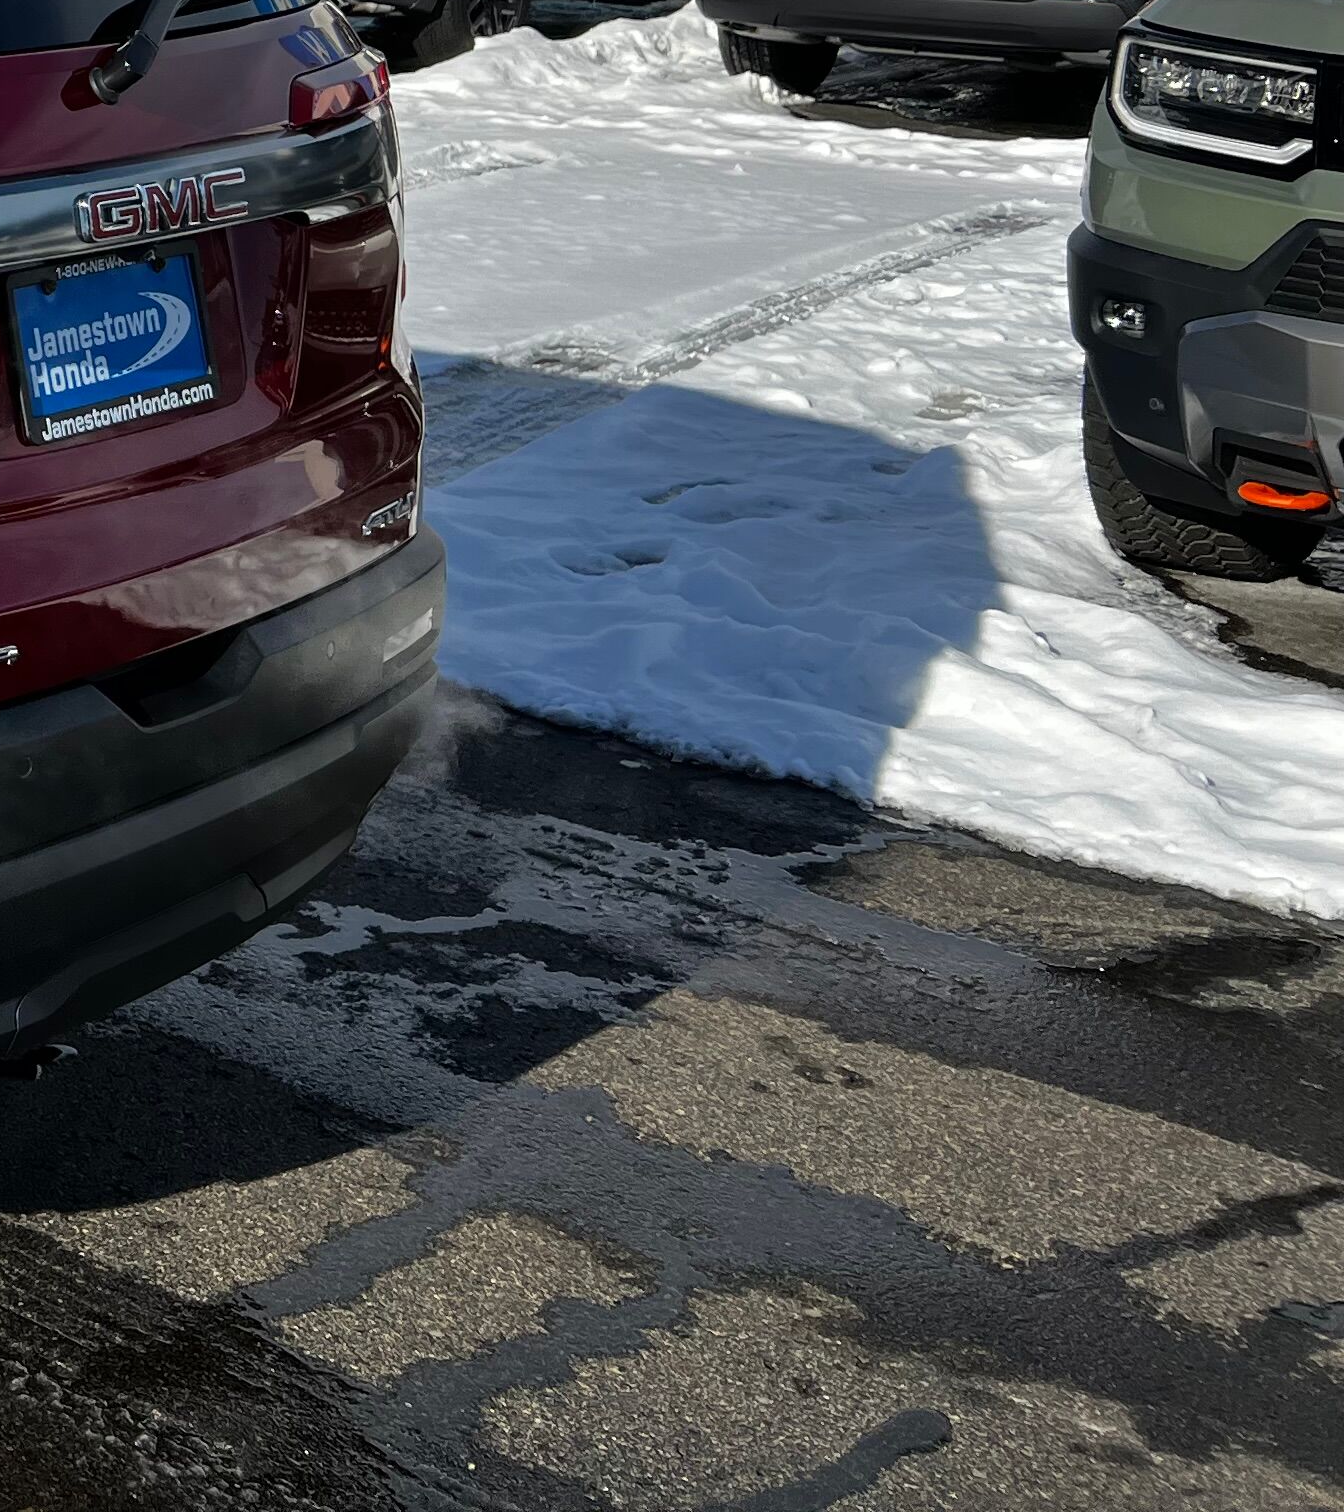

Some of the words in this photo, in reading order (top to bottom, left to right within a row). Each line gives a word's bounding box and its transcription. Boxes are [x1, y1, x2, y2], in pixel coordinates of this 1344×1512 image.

[76, 168, 249, 242] GMC
[27, 307, 161, 362] Jamestown
[29, 350, 110, 398] Honda
[41, 382, 213, 441] JamestownHonda.com
